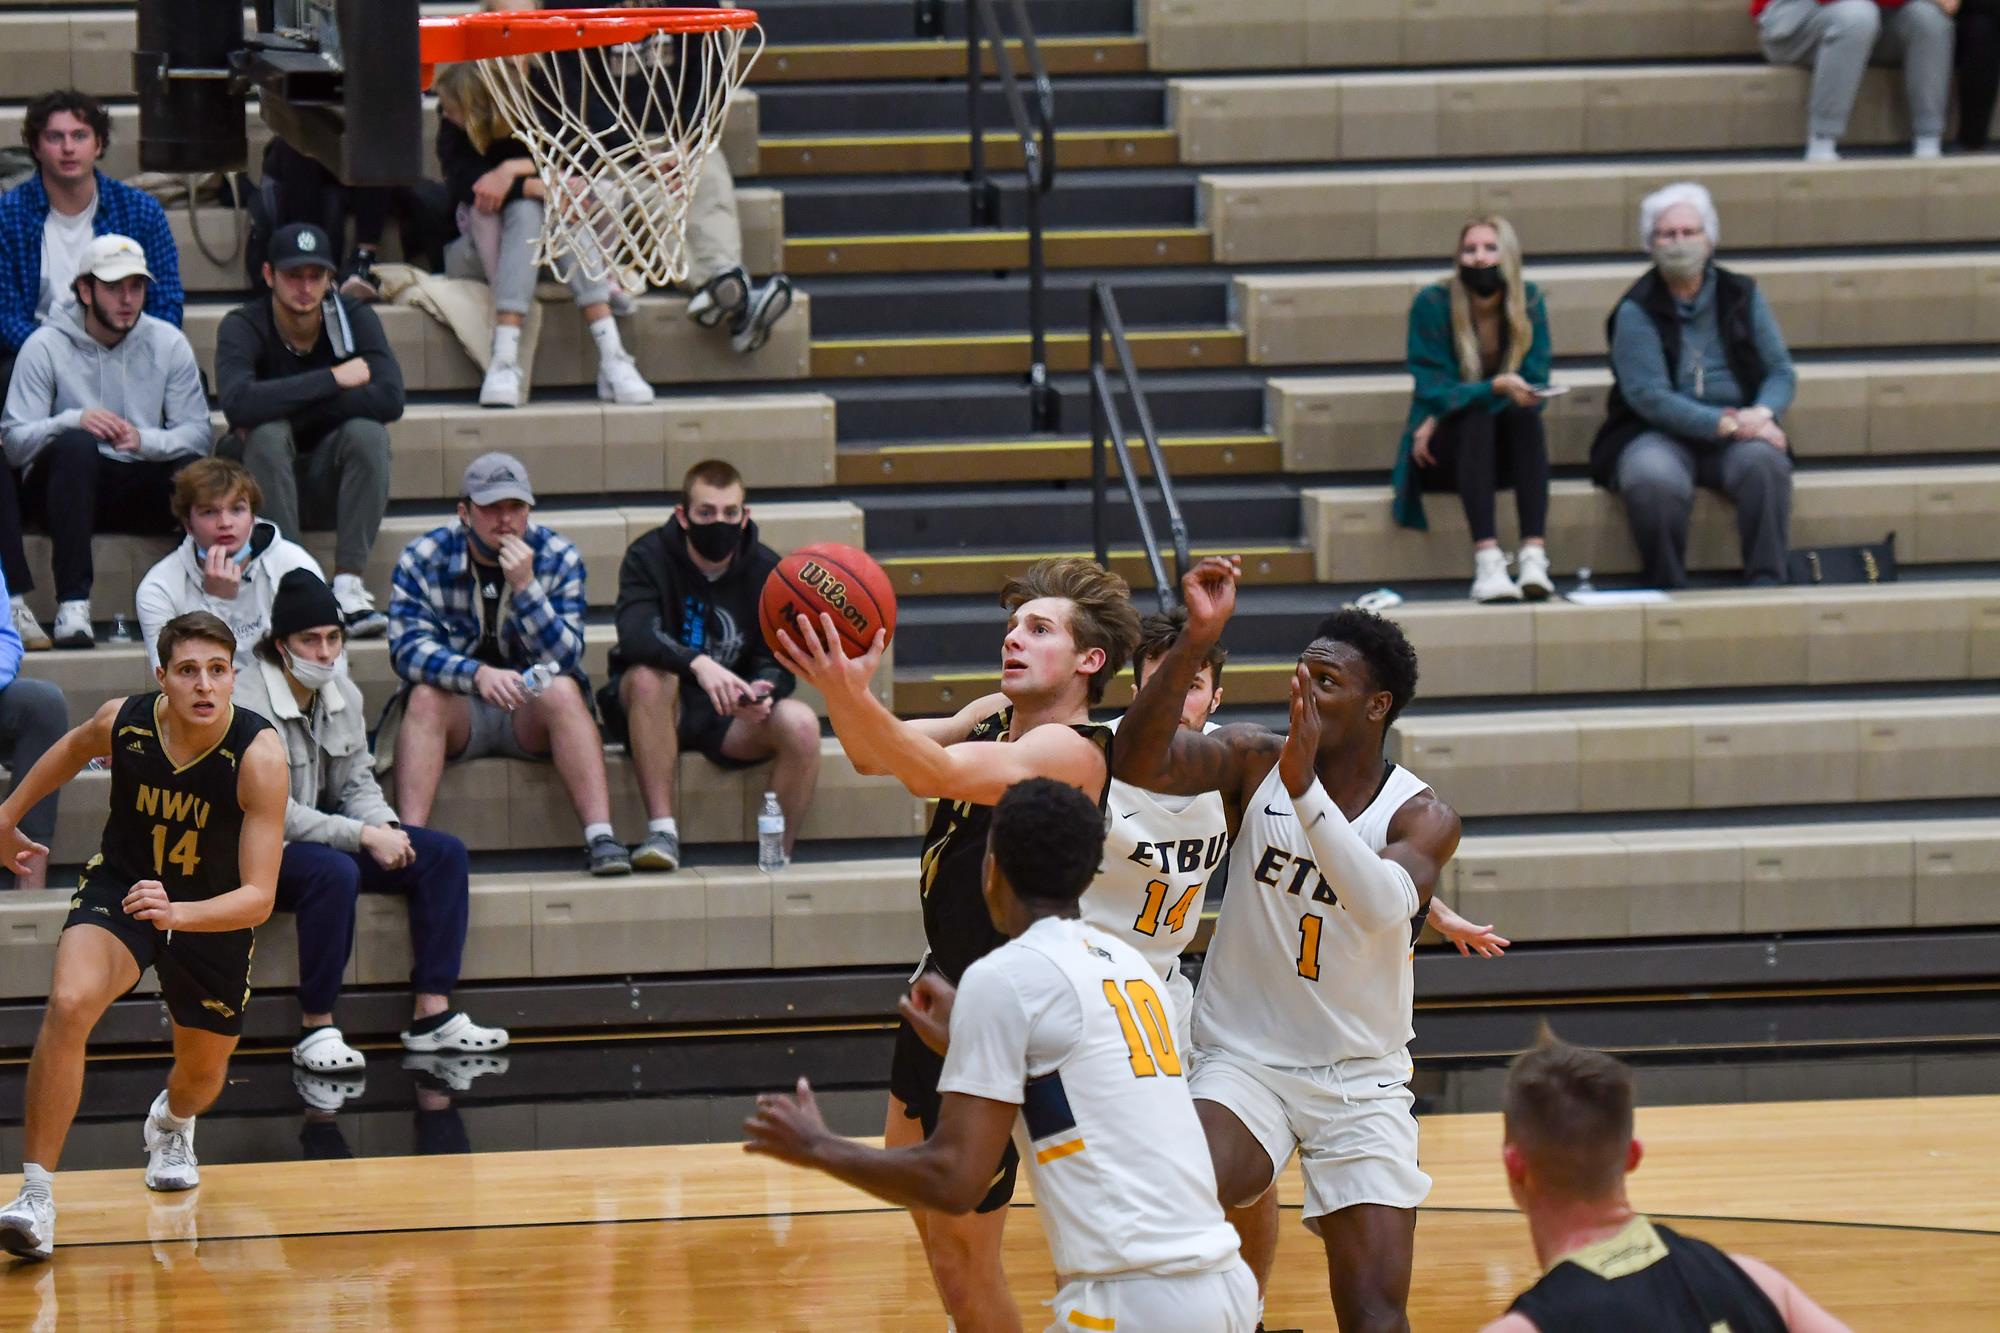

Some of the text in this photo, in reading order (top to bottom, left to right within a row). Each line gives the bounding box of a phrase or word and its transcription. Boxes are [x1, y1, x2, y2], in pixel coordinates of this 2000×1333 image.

[798, 561, 868, 634] Wilson
[136, 784, 210, 829] NWU
[152, 824, 200, 876] 14
[1127, 831, 1226, 875] ETBU
[1133, 879, 1203, 937] 14
[1296, 912, 1323, 982] 1
[1102, 979, 1182, 1078] 10
